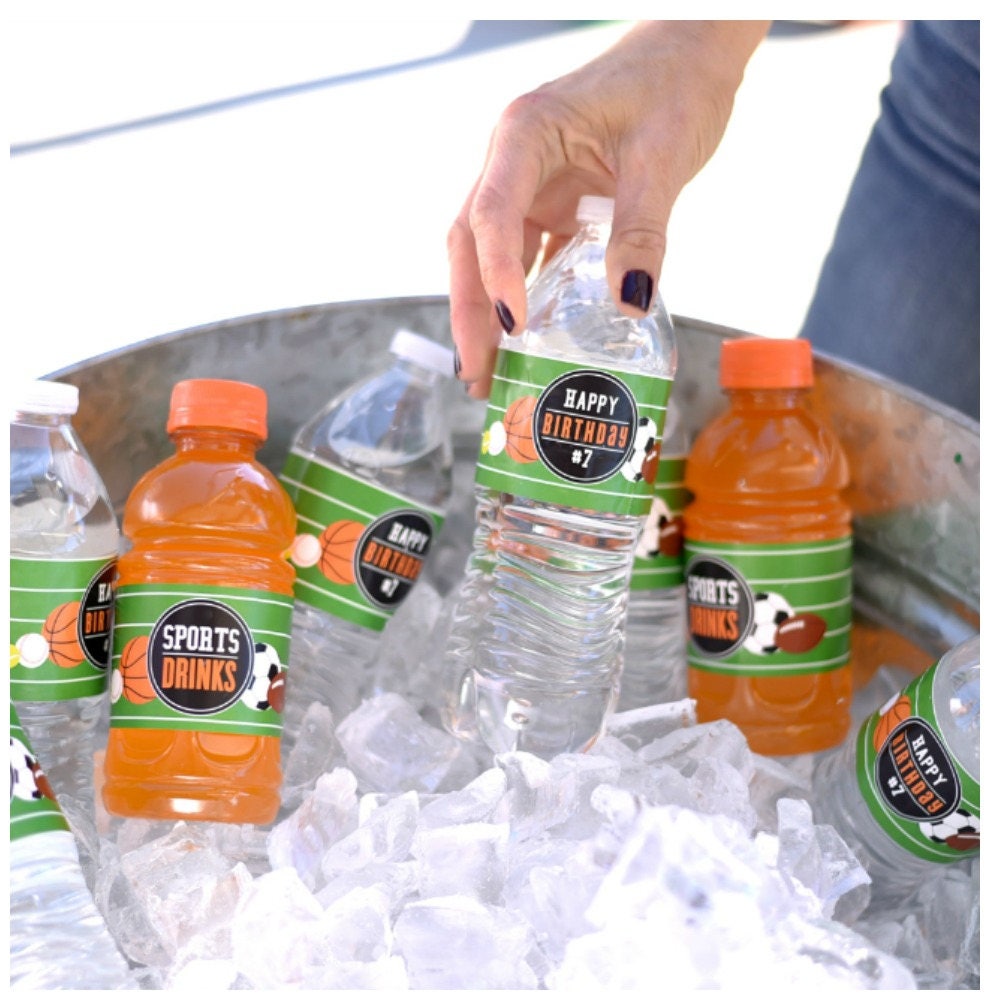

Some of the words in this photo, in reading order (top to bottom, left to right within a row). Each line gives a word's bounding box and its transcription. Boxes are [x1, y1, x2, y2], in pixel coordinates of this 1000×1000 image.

[563, 388, 619, 416] HAPPY
[571, 449, 593, 469] #7
[387, 522, 429, 552] HAPPY
[688, 577, 739, 605] SPORTS
[689, 605, 740, 641] DRINKS
[162, 624, 240, 653] SPORTS
[162, 657, 237, 692] DRINKS
[912, 734, 947, 786] HAPPY
[887, 776, 906, 796] #7
